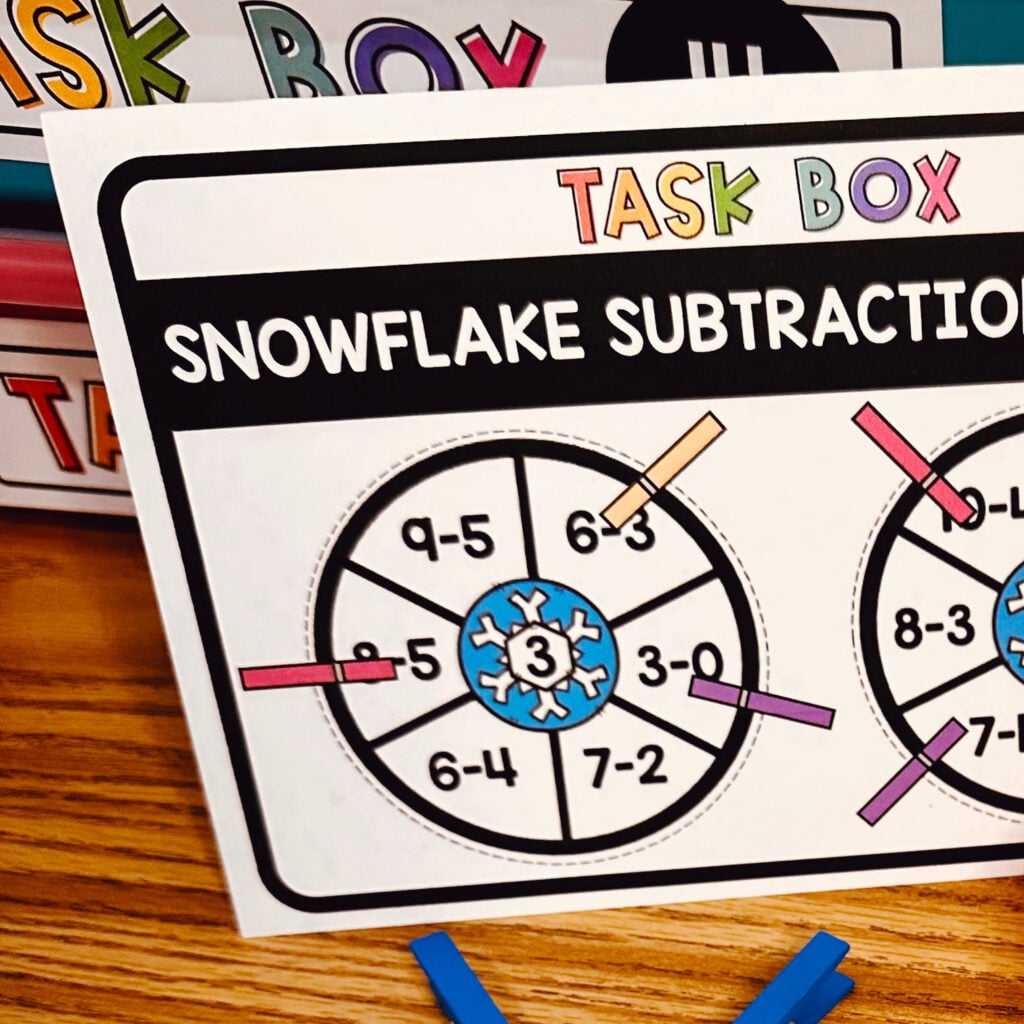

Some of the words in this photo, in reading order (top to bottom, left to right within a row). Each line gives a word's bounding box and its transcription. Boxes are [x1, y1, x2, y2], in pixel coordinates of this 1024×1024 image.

[0, 0, 190, 109] SK
[557, 161, 760, 245] TASK
[794, 150, 961, 233] BOX
[165, 300, 584, 383] SNOWFLAKE
[402, 514, 494, 561] 9-5
[566, 505, 655, 554] 6-3
[895, 605, 974, 649] 8-3
[528, 635, 557, 677] 3
[638, 642, 723, 685] 3-0
[429, 748, 517, 791] 6-4
[584, 745, 667, 788] 7-2
